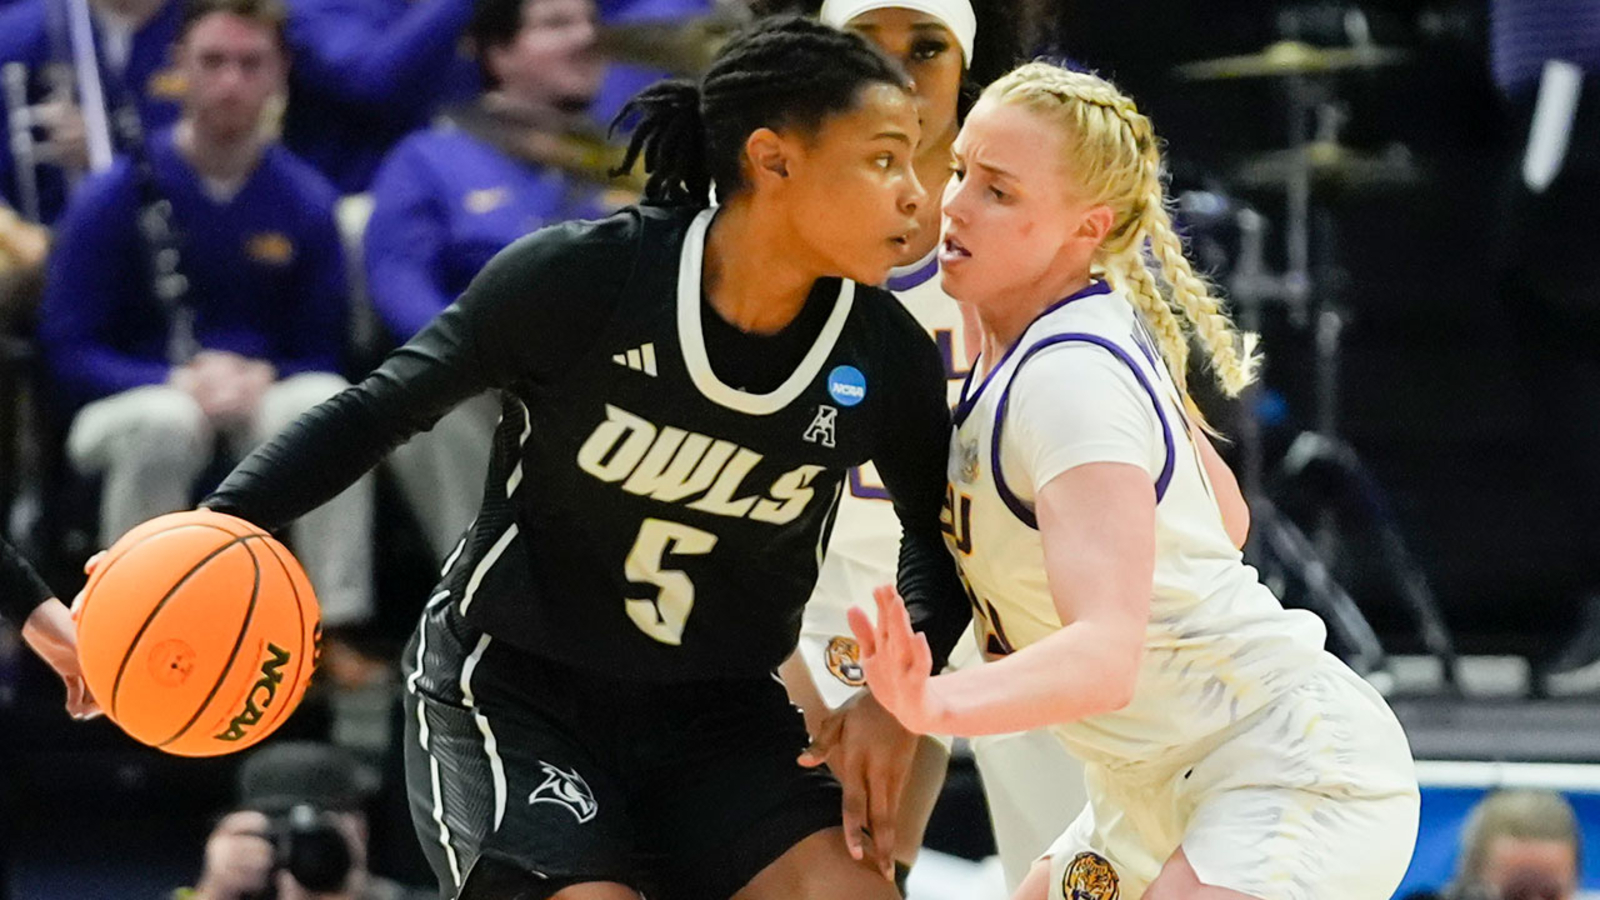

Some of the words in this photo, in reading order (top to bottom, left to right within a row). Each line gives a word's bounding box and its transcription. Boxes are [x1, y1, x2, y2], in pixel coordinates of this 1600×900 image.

[832, 382, 864, 398] NCAA
[577, 403, 827, 525] OWLS
[624, 517, 719, 645] 5
[213, 641, 291, 742] NCAA
